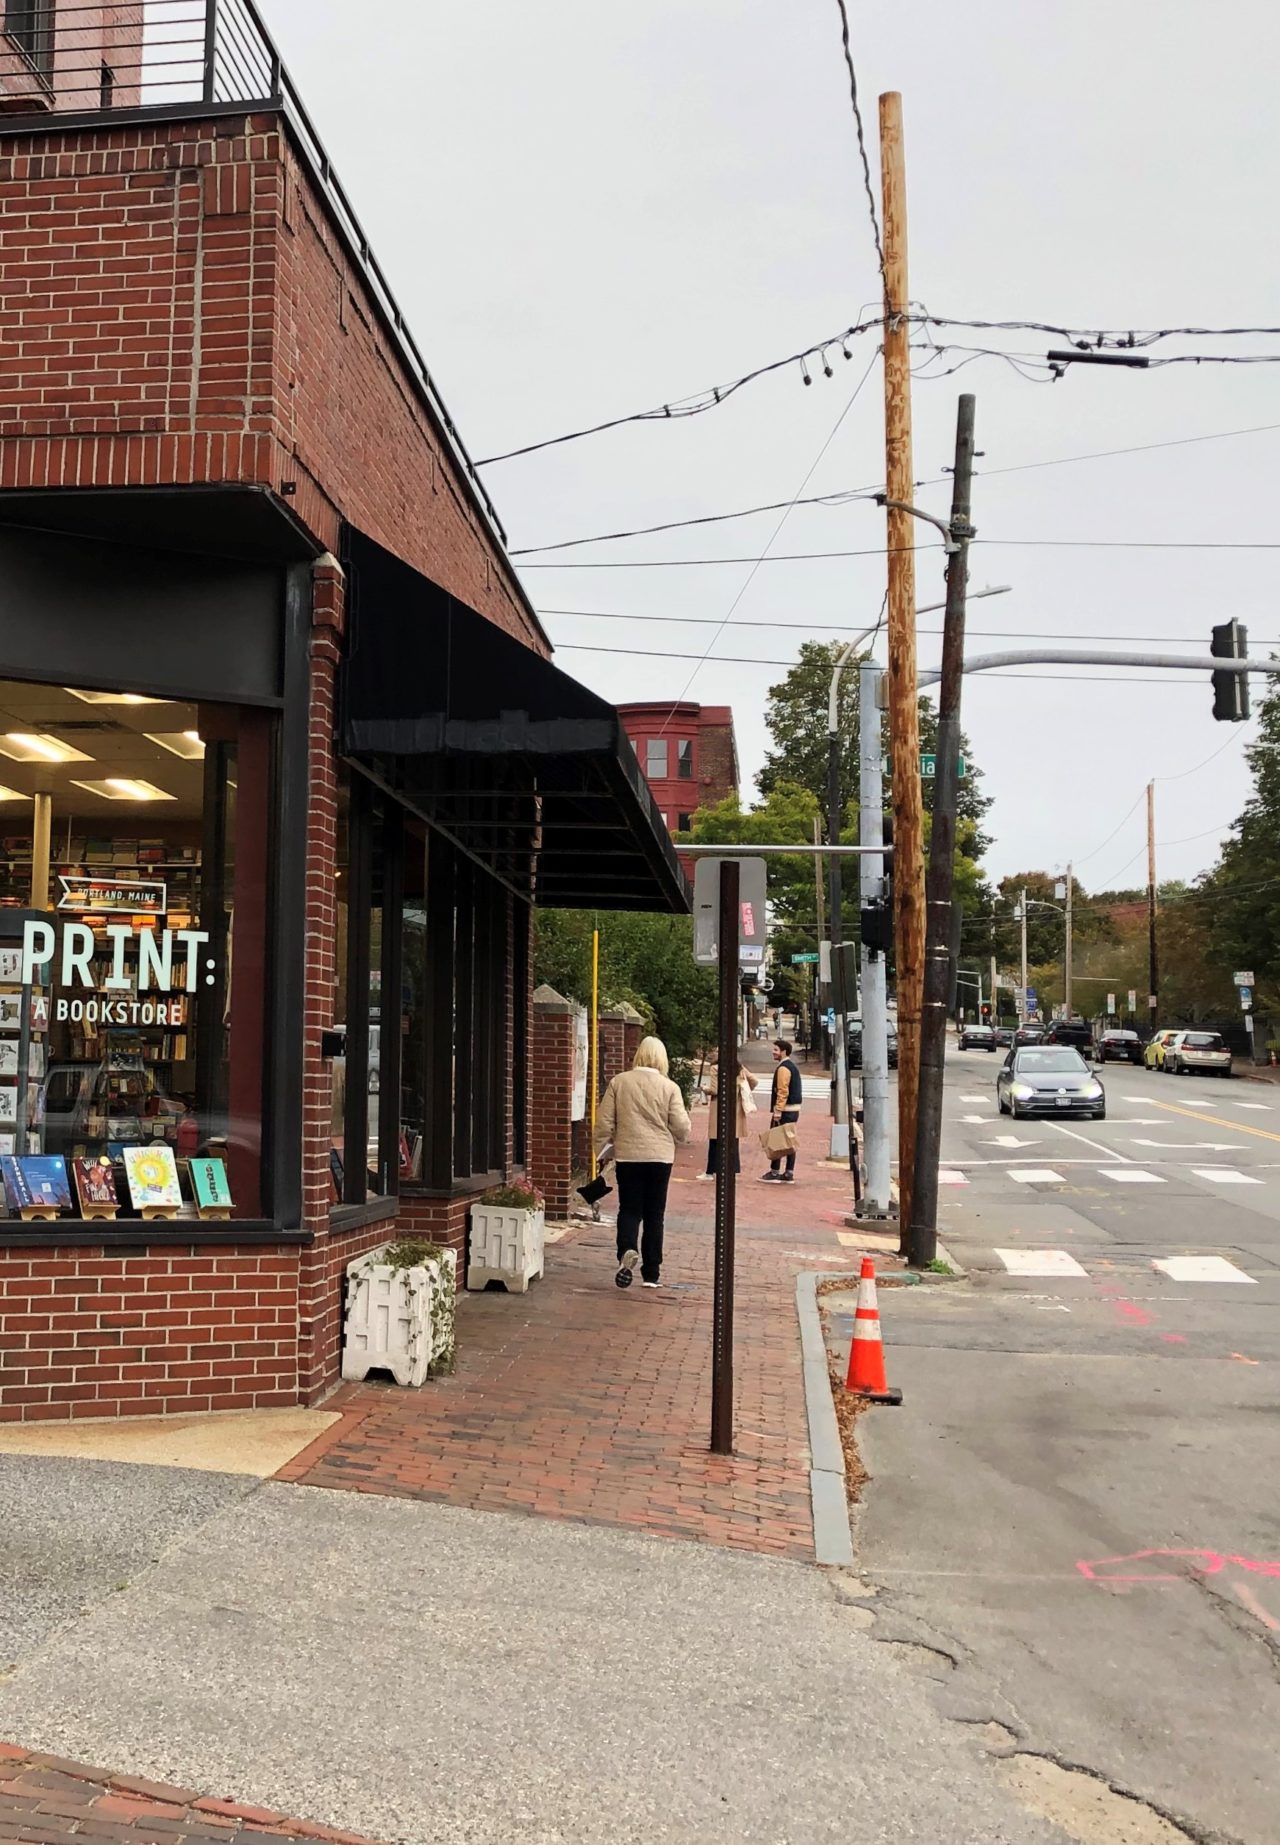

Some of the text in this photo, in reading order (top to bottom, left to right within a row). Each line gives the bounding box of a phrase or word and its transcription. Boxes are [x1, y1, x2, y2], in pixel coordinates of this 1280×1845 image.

[77, 888, 157, 902] PORTLAND, MAINE
[22, 920, 216, 993] PRINT:
[33, 998, 183, 1026] A BOOKSTORE
